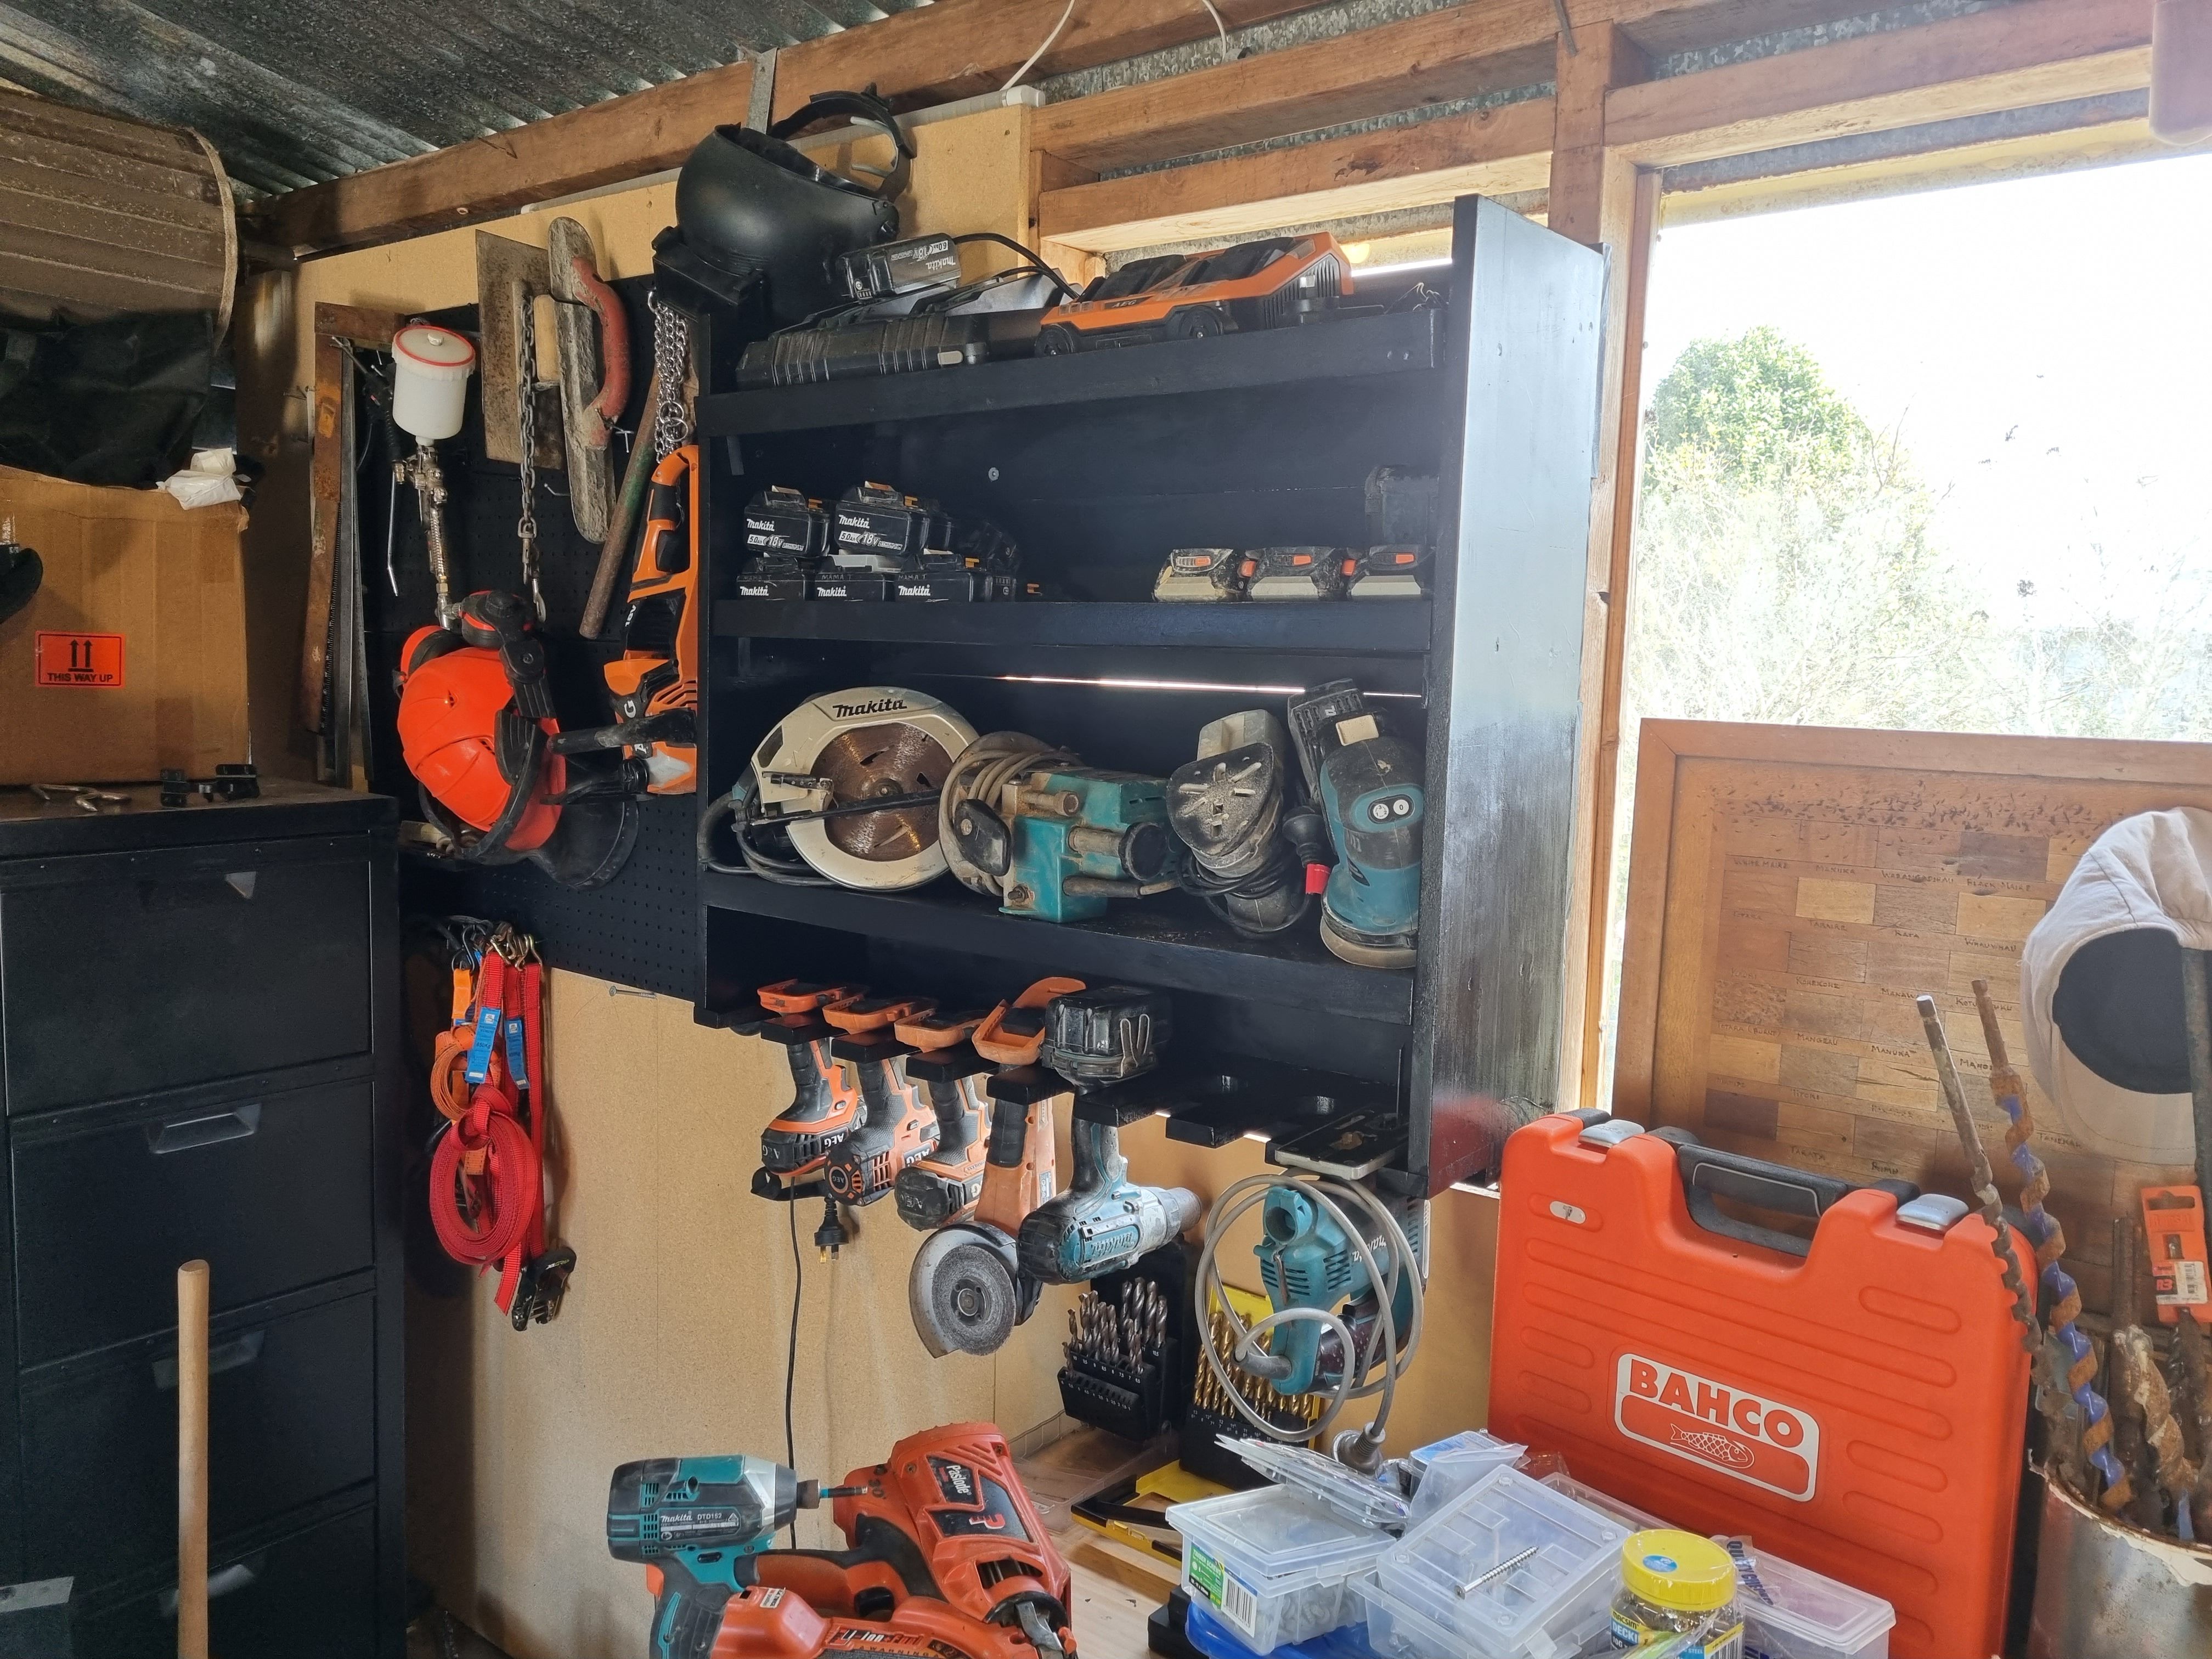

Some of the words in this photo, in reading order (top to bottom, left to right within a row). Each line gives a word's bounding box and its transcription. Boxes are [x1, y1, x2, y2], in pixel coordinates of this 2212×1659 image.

[1111, 300, 1137, 308] AEG
[48, 673, 71, 681] THIS
[75, 674, 97, 682] WAY
[99, 674, 113, 682] UP
[624, 700, 647, 754] AG
[825, 1133, 844, 1147] AEG
[833, 1175, 844, 1183] AEG
[1630, 1359, 1803, 1448] BAHCO
